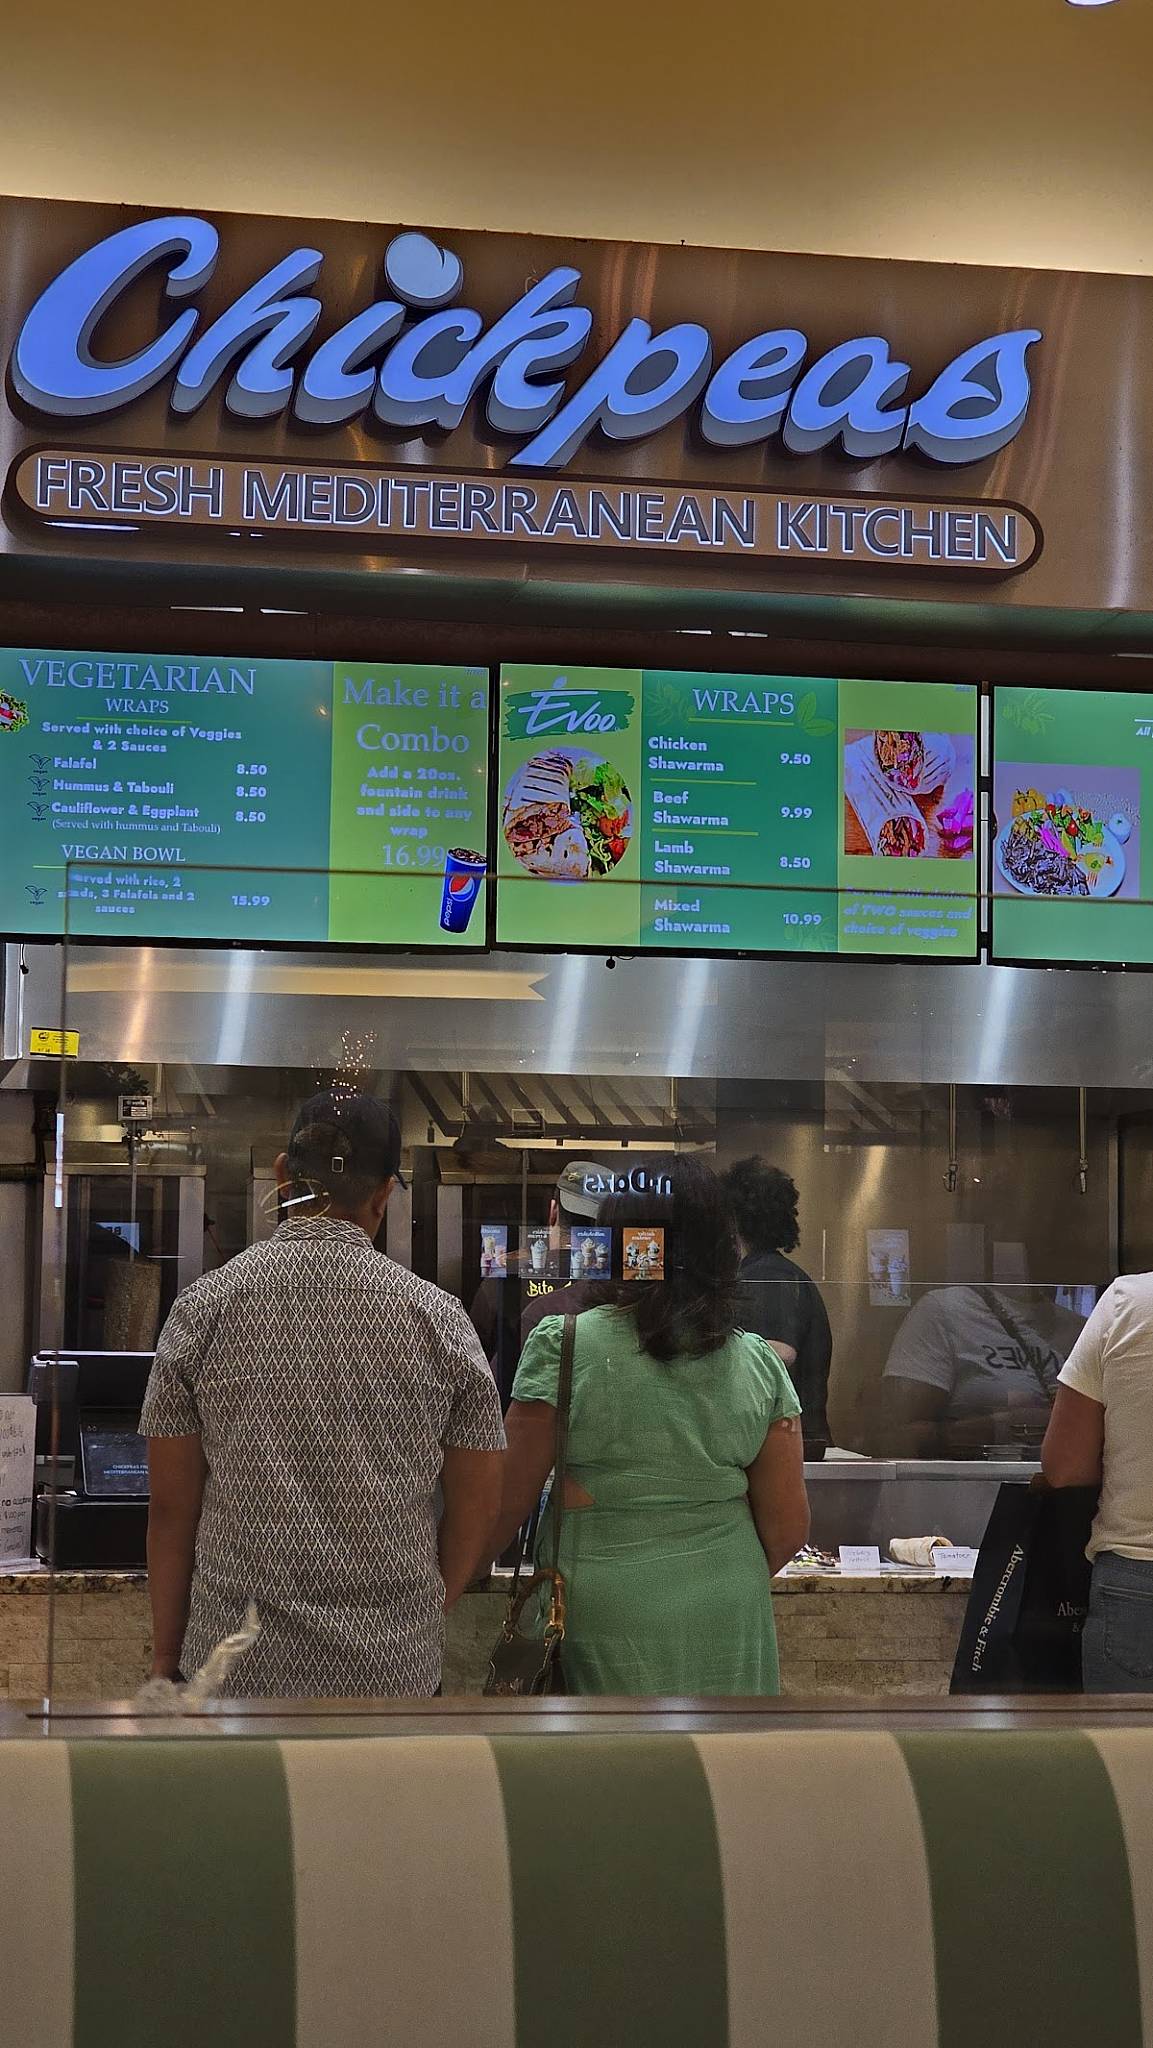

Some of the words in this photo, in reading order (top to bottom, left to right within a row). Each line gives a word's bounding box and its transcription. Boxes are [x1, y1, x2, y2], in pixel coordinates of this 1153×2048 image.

[12, 216, 1043, 466] Chickpeas
[36, 456, 224, 518] FRESH
[243, 470, 756, 548] MEDITERRANEAN
[777, 501, 1017, 563] KITCHEN
[19, 659, 257, 695] VEGETARIAN
[342, 677, 429, 708] Make
[439, 681, 460, 708] it
[470, 690, 488, 709] a
[106, 698, 169, 713] WRAPS
[693, 688, 794, 715] WRAPS
[42, 722, 90, 734] Served
[94, 723, 122, 735] with
[126, 724, 167, 737] choice
[172, 725, 186, 737] of
[189, 726, 242, 741] Veggies
[356, 723, 470, 753] Combo
[1135, 727, 1151, 736] All
[92, 740, 103, 751] &
[107, 740, 117, 751] 2
[121, 741, 167, 752] Sauces
[648, 735, 708, 751] Chicken
[53, 757, 97, 770] Falafel
[648, 756, 724, 772] Shawarma
[780, 752, 811, 765] 9.50
[236, 763, 267, 775] 8.50
[367, 765, 398, 779] Add
[403, 770, 412, 779] a
[53, 779, 109, 793] Hummus
[113, 782, 123, 793] &
[127, 781, 174, 794] Tabouli
[236, 786, 267, 798] 8.50
[360, 783, 422, 798] fountain
[427, 786, 469, 799] drink
[653, 791, 689, 804] Beef
[51, 802, 125, 815] Cauliflower
[128, 804, 138, 816] &
[142, 804, 199, 819] Eggplant
[235, 811, 266, 823] 8.50
[356, 803, 385, 816] and
[389, 804, 420, 817] side
[424, 807, 440, 817] to
[445, 809, 472, 821] any
[653, 810, 729, 826] Shawarma
[781, 806, 812, 819] 9.99
[52, 819, 89, 831] (Served
[91, 820, 113, 831] with
[115, 821, 159, 832] hummus
[161, 822, 179, 832] and
[181, 822, 221, 835] Tabouli)
[390, 825, 428, 838] wrap
[61, 844, 128, 860] VEGAN
[132, 846, 186, 862] BOWL
[654, 840, 694, 854] Lamb
[383, 844, 445, 867] 16.99
[780, 856, 811, 869] 8.50
[654, 860, 730, 875] Shawarma
[116, 873, 140, 885] with
[143, 876, 169, 888] rice,
[173, 876, 181, 887] 2
[102, 889, 110, 898] 3
[113, 889, 158, 900] Falafels
[161, 891, 183, 900] and
[187, 892, 195, 901] 2
[231, 895, 270, 906] 15.99
[95, 905, 135, 914] sauces
[443, 897, 453, 927] pepsi
[654, 899, 700, 912] Mixed
[654, 918, 730, 934] Shawarma
[783, 913, 822, 925] 10.99
[984, 1544, 1024, 1625] Abercrombie
[979, 1625, 989, 1637] &
[972, 1637, 987, 1672] Fitch
